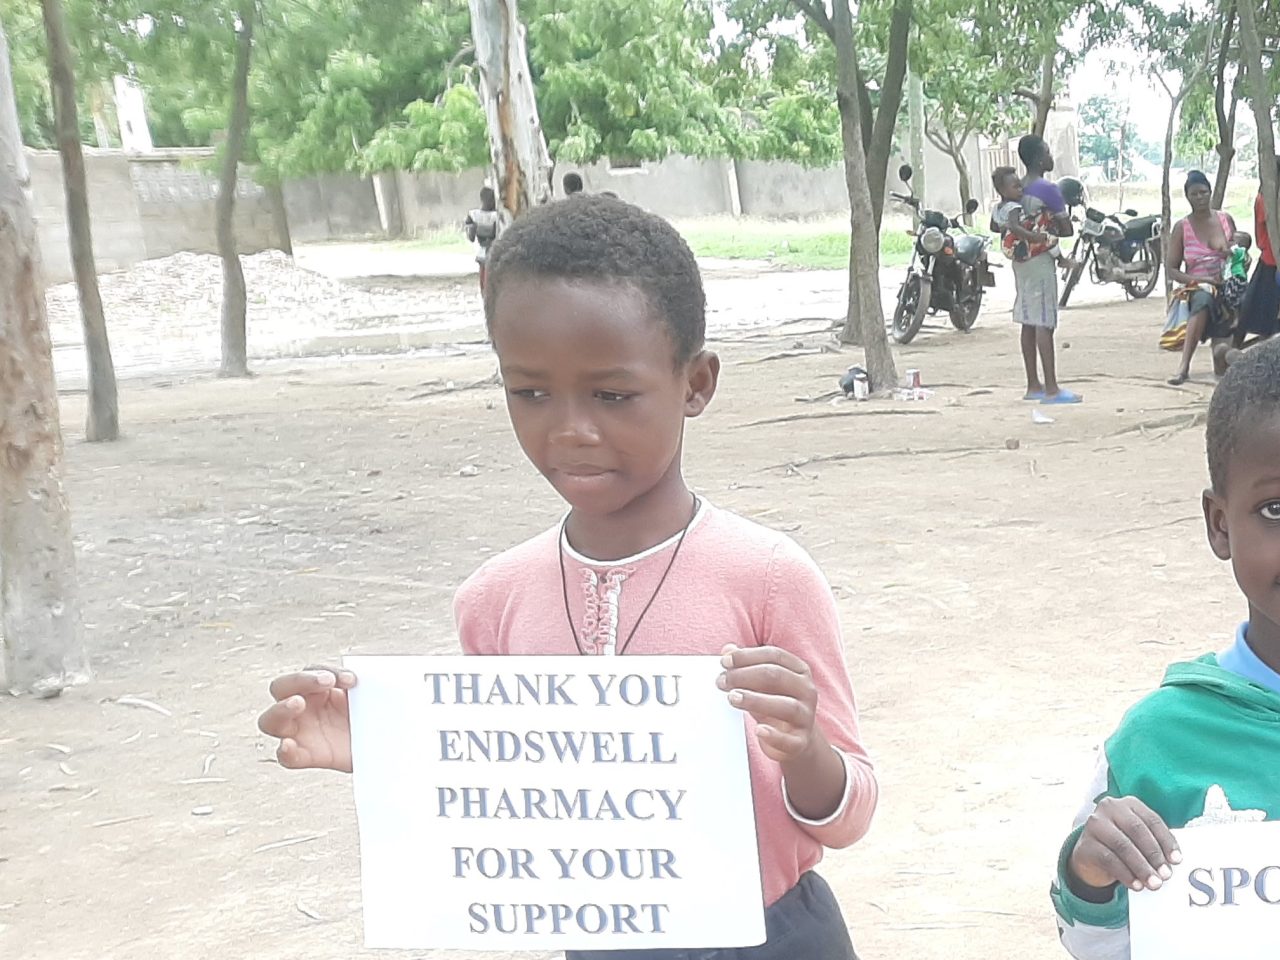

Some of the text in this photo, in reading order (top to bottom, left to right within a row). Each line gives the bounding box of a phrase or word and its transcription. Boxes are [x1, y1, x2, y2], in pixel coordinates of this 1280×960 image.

[424, 672, 682, 707] THANK YOU
[437, 730, 678, 764] ENDSWELL
[435, 786, 687, 821] PHARMACY
[451, 846, 682, 880] FOR YOUR
[467, 902, 670, 935] SUPPORT
